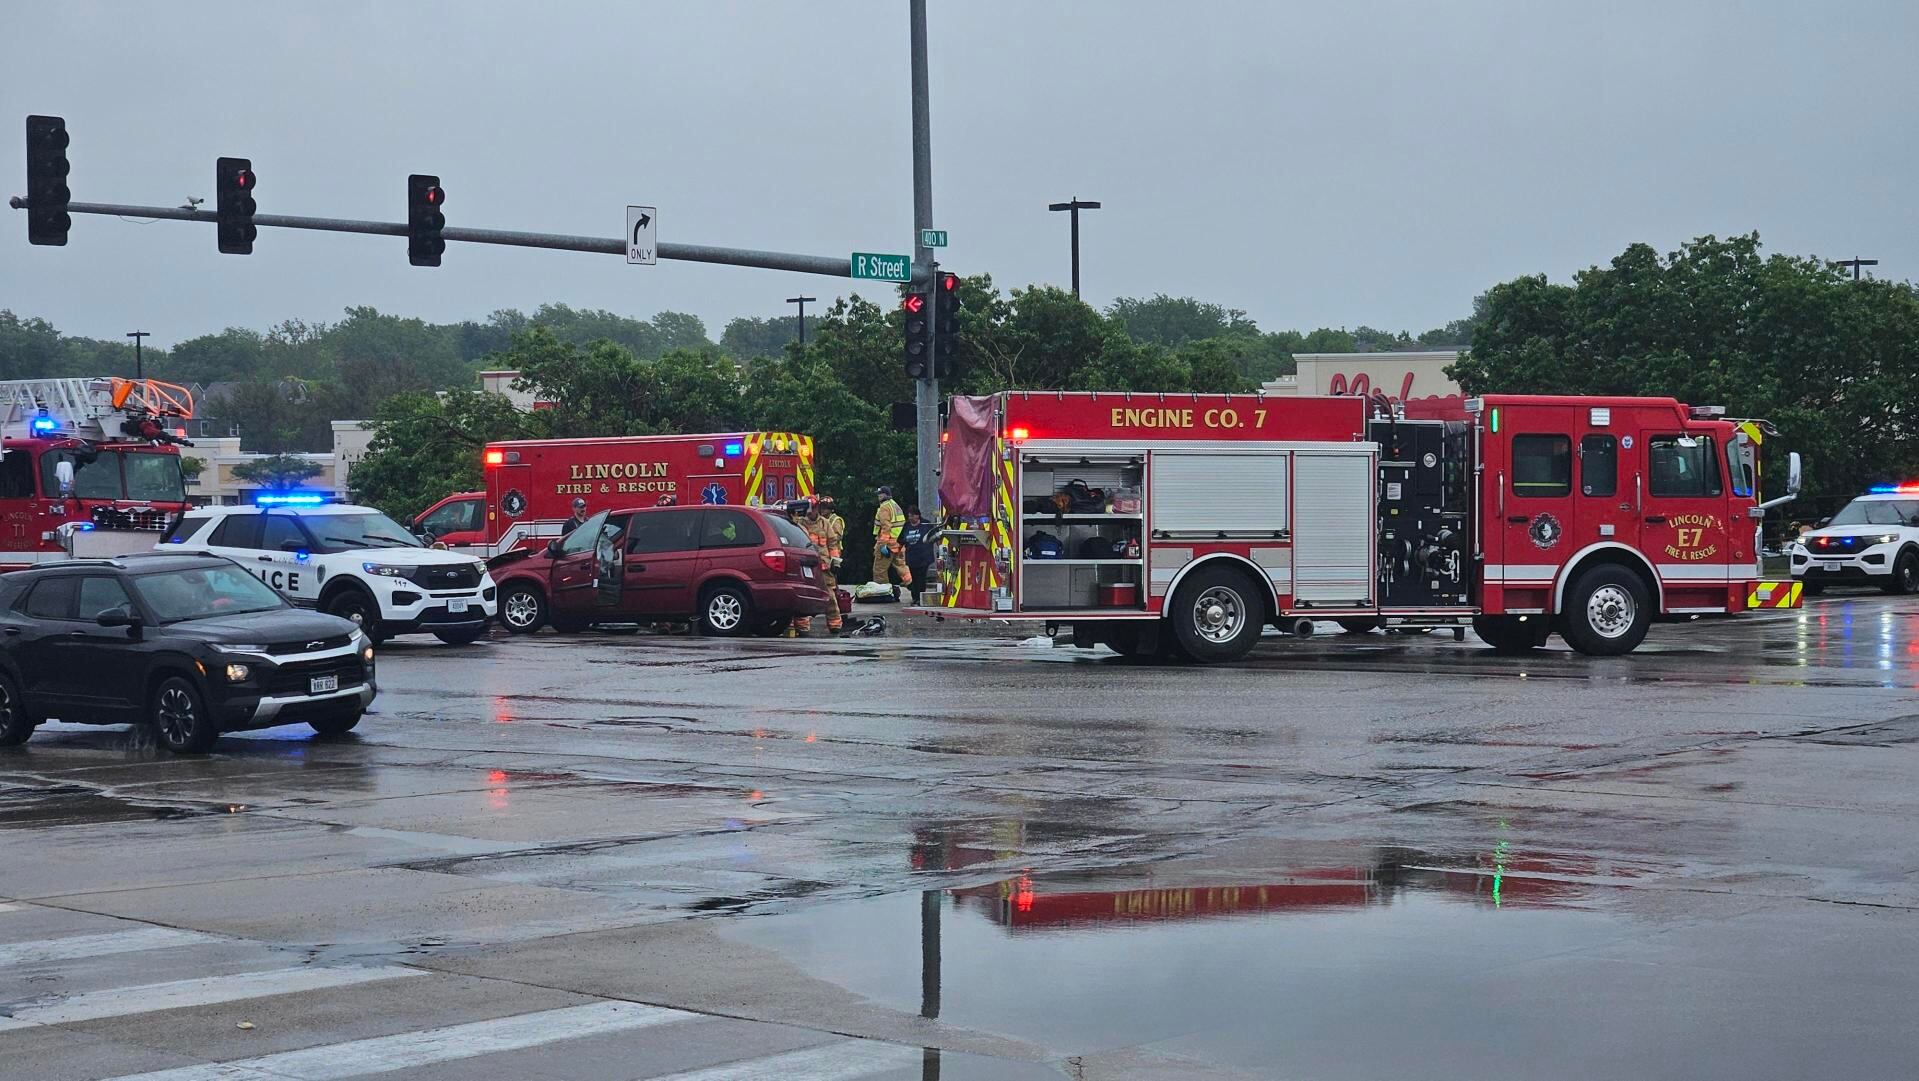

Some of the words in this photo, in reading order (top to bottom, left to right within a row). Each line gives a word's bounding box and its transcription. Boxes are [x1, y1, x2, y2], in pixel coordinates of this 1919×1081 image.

[924, 231, 937, 246] 400
[939, 232, 945, 246] N
[631, 248, 652, 260] ONLY
[858, 255, 867, 276] R
[870, 256, 905, 278] Street
[1111, 408, 1194, 428] ENGINE
[1204, 408, 1245, 428] CO.
[1254, 409, 1267, 429] 7
[570, 462, 669, 479] LINCOLN
[557, 483, 592, 494] FIRE
[600, 483, 610, 493] &
[618, 481, 676, 493] RESCUE
[1669, 515, 1712, 528] LINCOLN
[1678, 528, 1703, 547] E7
[1665, 544, 1680, 559] FIRE
[1682, 550, 1687, 560] &
[1690, 544, 1717, 560] RESCUE
